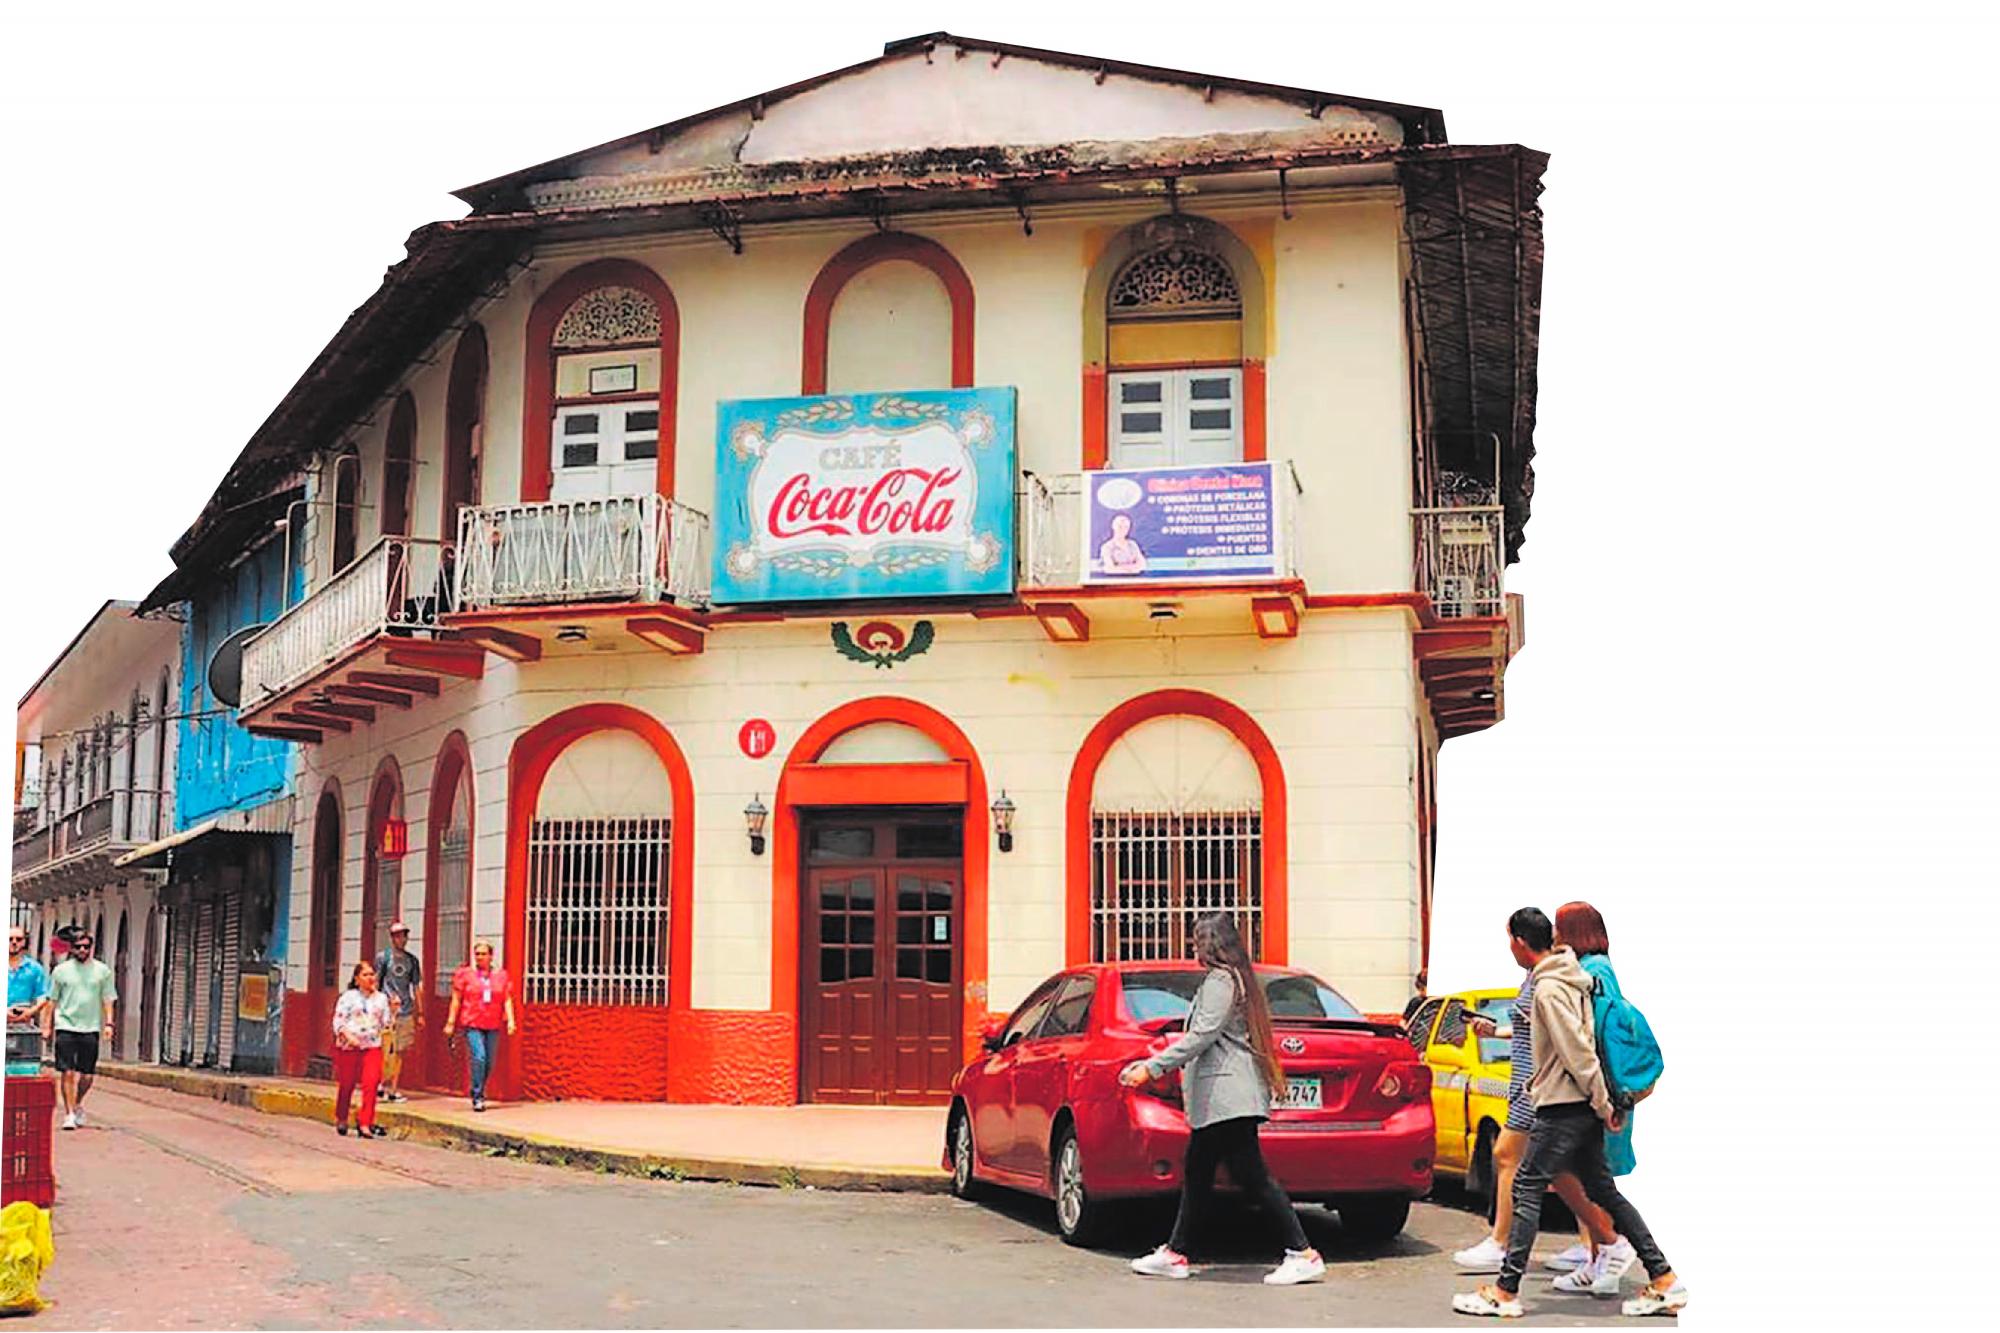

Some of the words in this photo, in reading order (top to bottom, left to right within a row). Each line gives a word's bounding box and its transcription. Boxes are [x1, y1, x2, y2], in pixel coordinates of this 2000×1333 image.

[819, 439, 901, 470] CAFÉ
[1201, 493, 1212, 502] DE
[1215, 490, 1264, 502] PORCELANA
[768, 467, 961, 538] Coca-Cola
[1220, 512, 1266, 523] FLEXIBLES
[1227, 535, 1267, 544] PUENTES
[1196, 546, 1232, 556] DIENTES
[1234, 545, 1246, 554] DE
[1248, 544, 1267, 554] ORO
